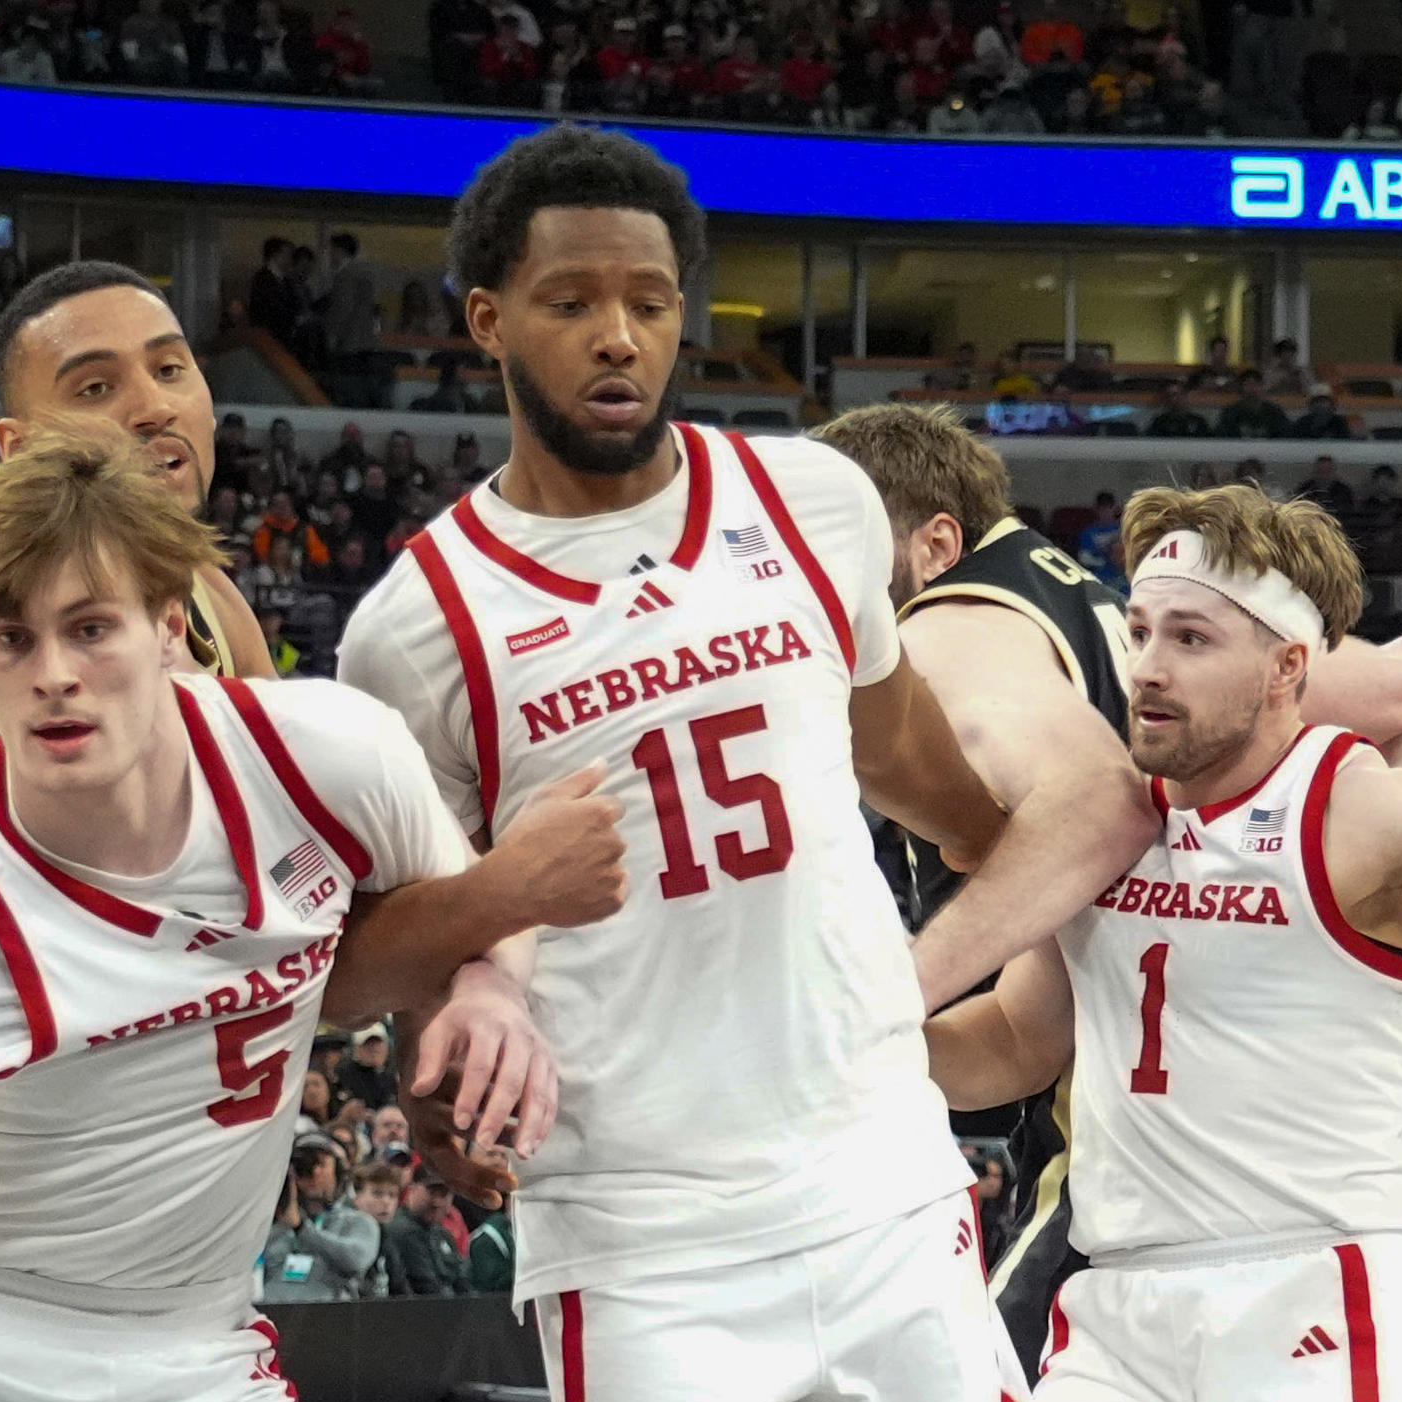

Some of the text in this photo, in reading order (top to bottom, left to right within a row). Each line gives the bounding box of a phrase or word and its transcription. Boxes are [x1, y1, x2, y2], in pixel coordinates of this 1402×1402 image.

[510, 623, 567, 650] GRADUATE
[519, 621, 811, 744] NEBRASKA
[632, 704, 793, 900] 15
[1090, 871, 1290, 926] EBRASKA
[207, 1001, 294, 1128] 5
[1130, 943, 1169, 1094] 1
